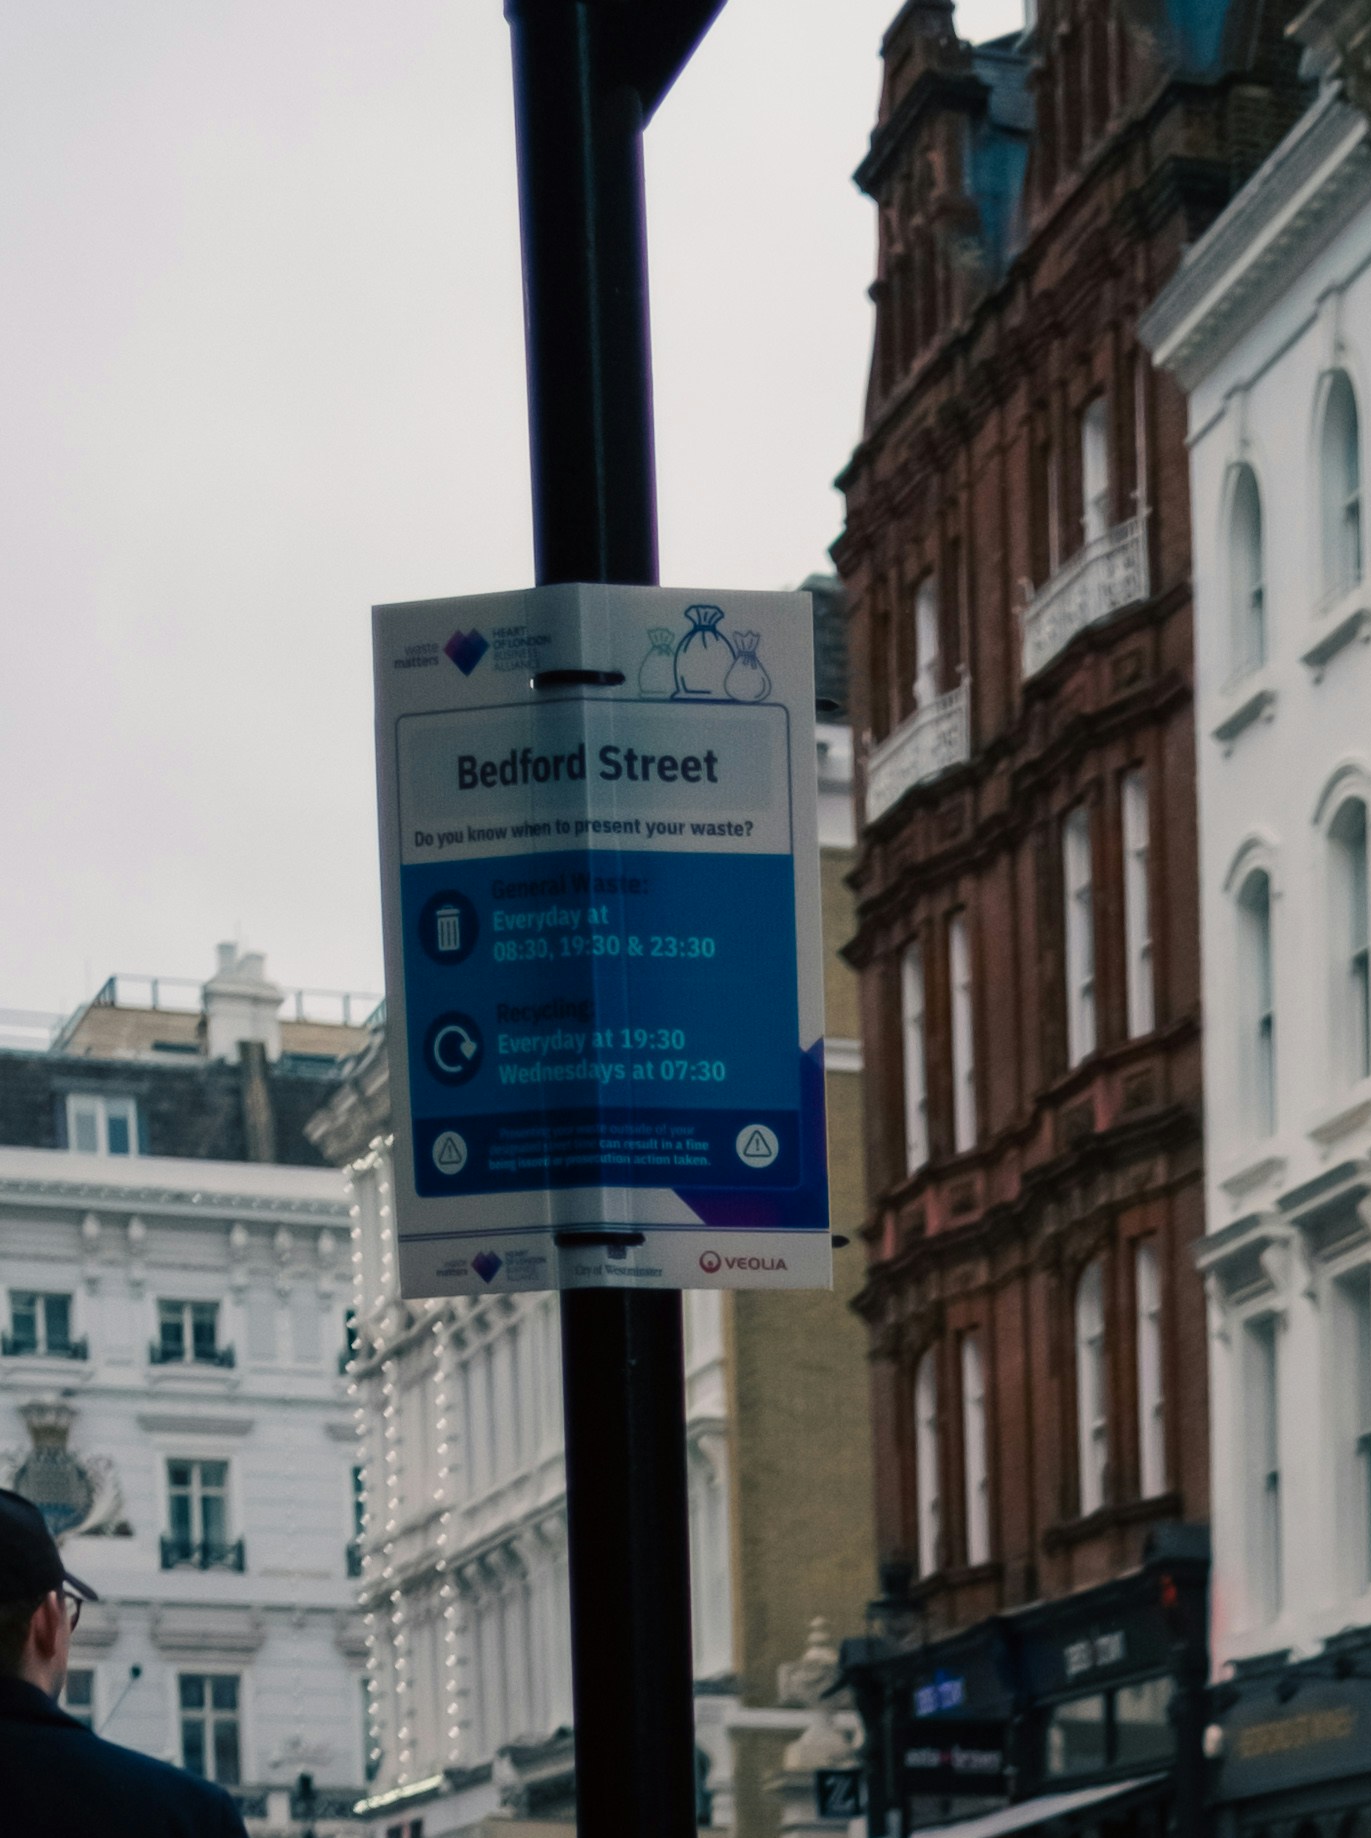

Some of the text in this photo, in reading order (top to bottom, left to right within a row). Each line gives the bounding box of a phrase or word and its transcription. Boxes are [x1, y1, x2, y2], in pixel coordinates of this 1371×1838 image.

[457, 743, 719, 790] Bedford Street
[415, 820, 754, 849] Do you know when to present your waste?
[491, 872, 649, 899] General Waste:
[493, 904, 610, 932] Everyday at
[493, 935, 716, 963] 08:30, 19:30 & 23:30
[497, 1029, 686, 1056] Everyday at 19:30
[498, 1060, 726, 1085] Wednesdays at 07:30
[599, 1140, 622, 1150] can
[624, 1139, 658, 1151] result
[661, 1139, 673, 1150] in
[676, 1142, 682, 1150] a
[686, 1139, 709, 1151] fine
[633, 1154, 671, 1166] action
[725, 1257, 788, 1271] VEOLIA
